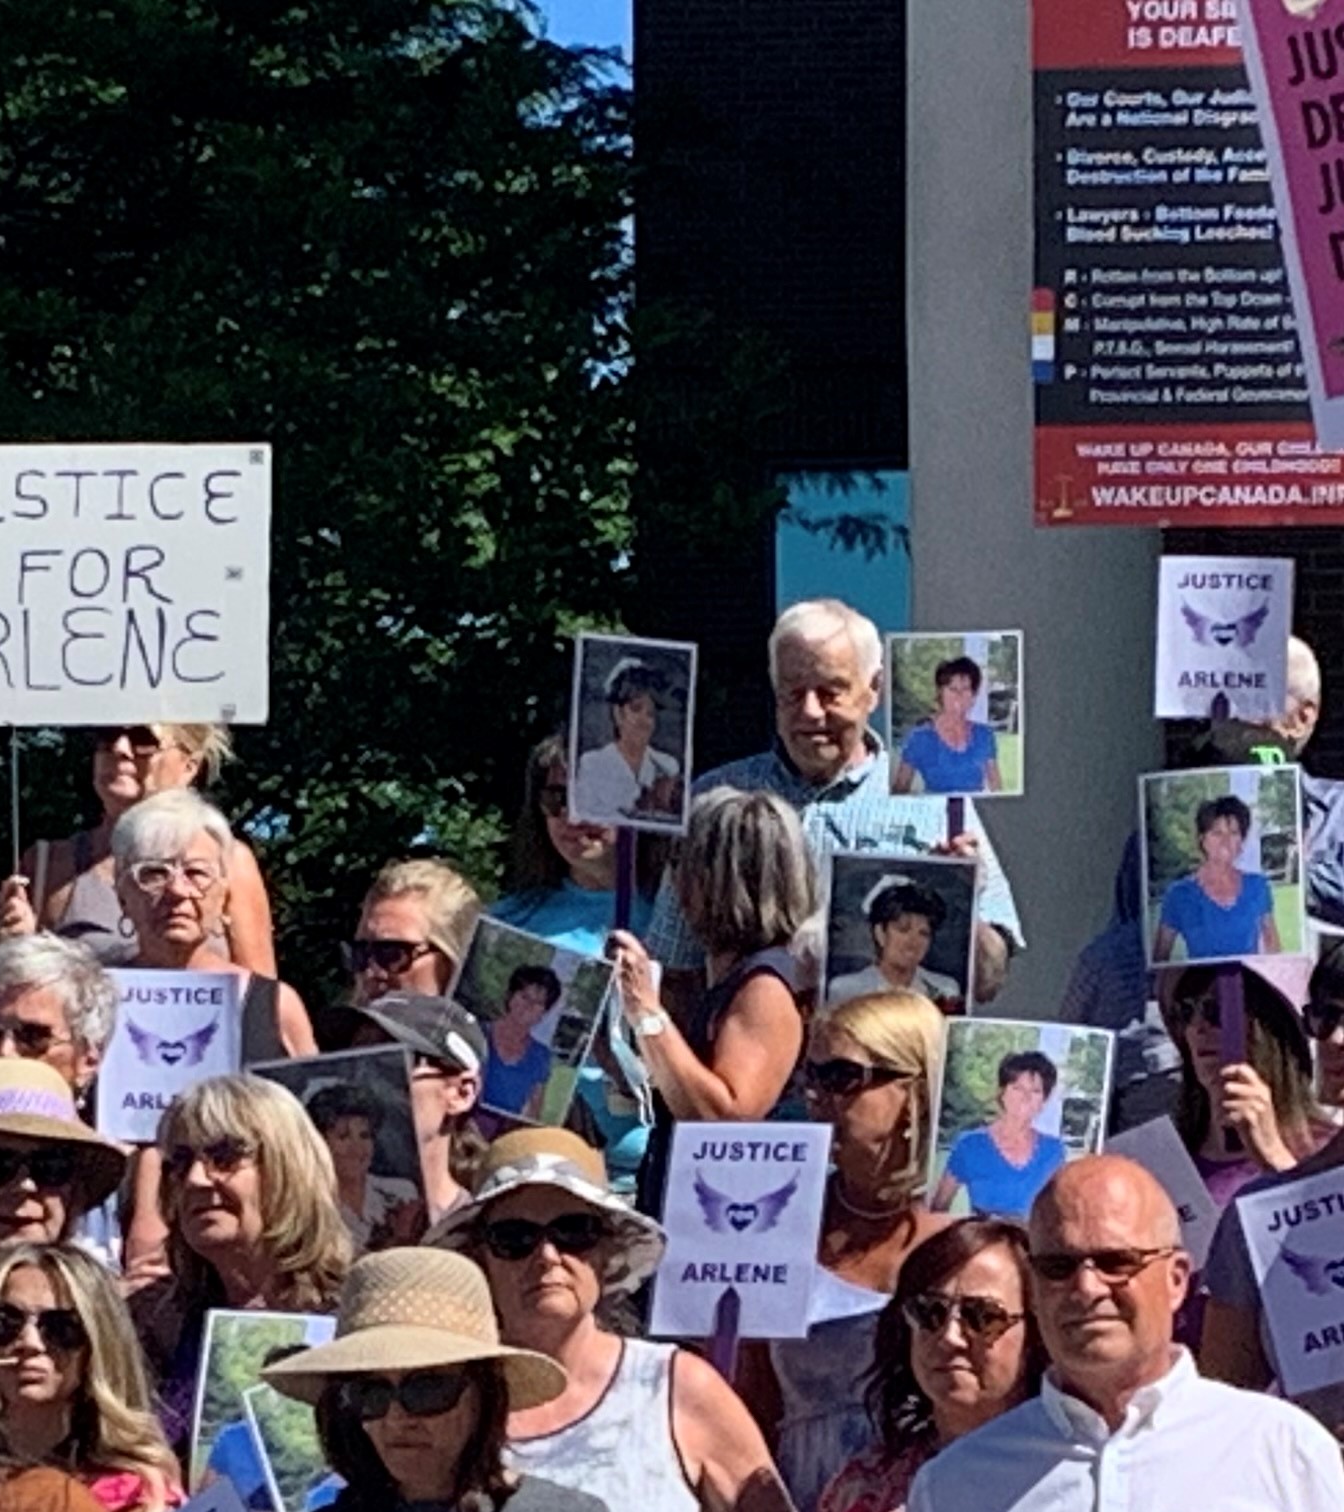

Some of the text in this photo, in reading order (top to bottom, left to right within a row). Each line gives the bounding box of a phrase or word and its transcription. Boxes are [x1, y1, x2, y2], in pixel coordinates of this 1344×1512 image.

[1126, 0, 1197, 20] YOUR
[1128, 25, 1242, 48] IS DEAFE
[18, 545, 174, 604] FOR
[1177, 573, 1275, 591] JUSTICE
[1178, 671, 1268, 689] ARLENE
[122, 987, 224, 1005] JUSTICE
[122, 1092, 179, 1110] ARL
[693, 1142, 807, 1162] JUSTICE
[681, 1262, 788, 1284] ARLENE
